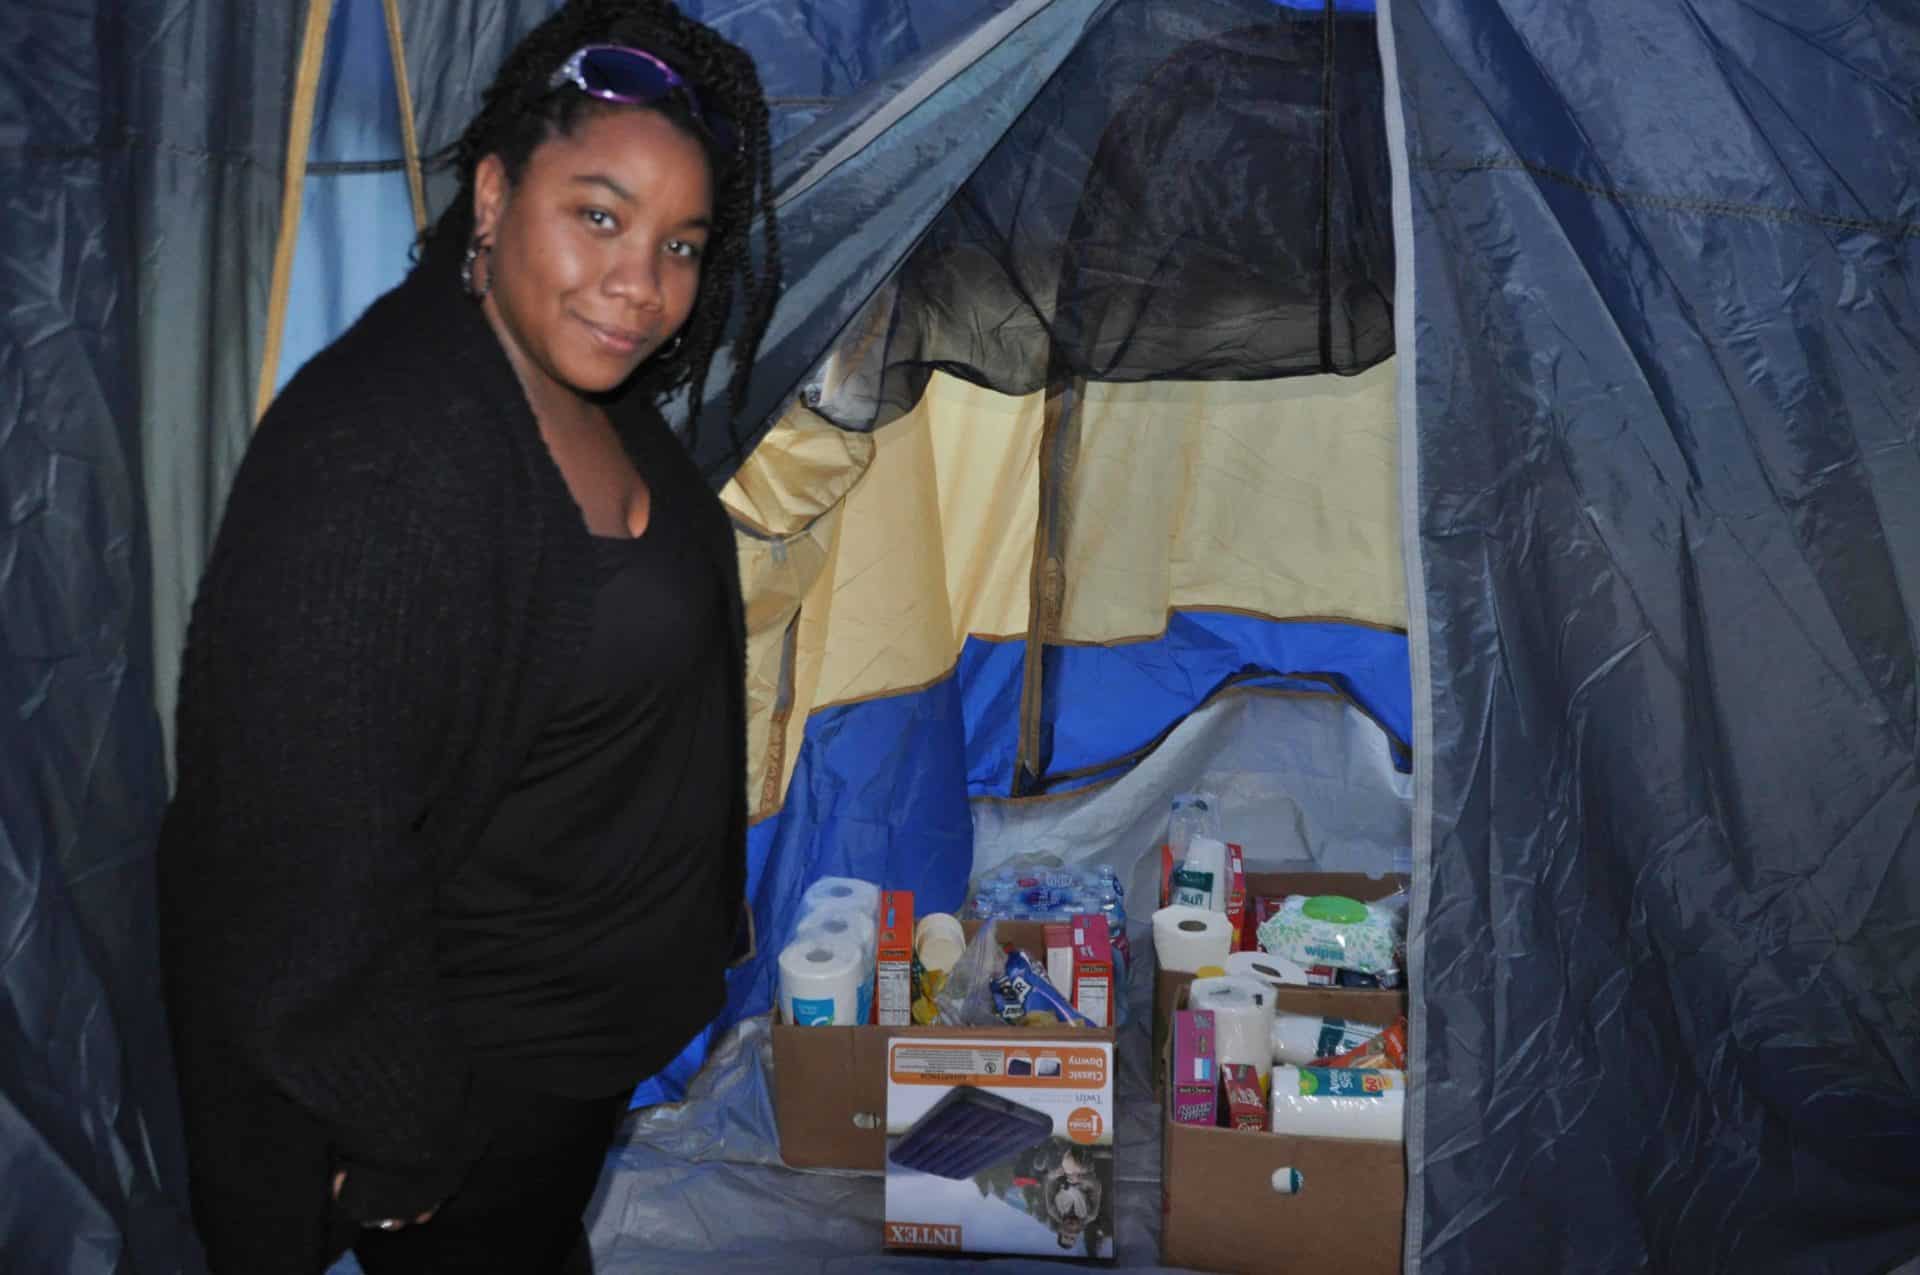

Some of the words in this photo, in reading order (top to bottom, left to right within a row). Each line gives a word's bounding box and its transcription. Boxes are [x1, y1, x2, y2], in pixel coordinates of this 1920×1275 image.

[1068, 1071, 1103, 1081] Classic
[1075, 1094, 1103, 1104] Twin
[890, 1226, 958, 1246] INTEX
